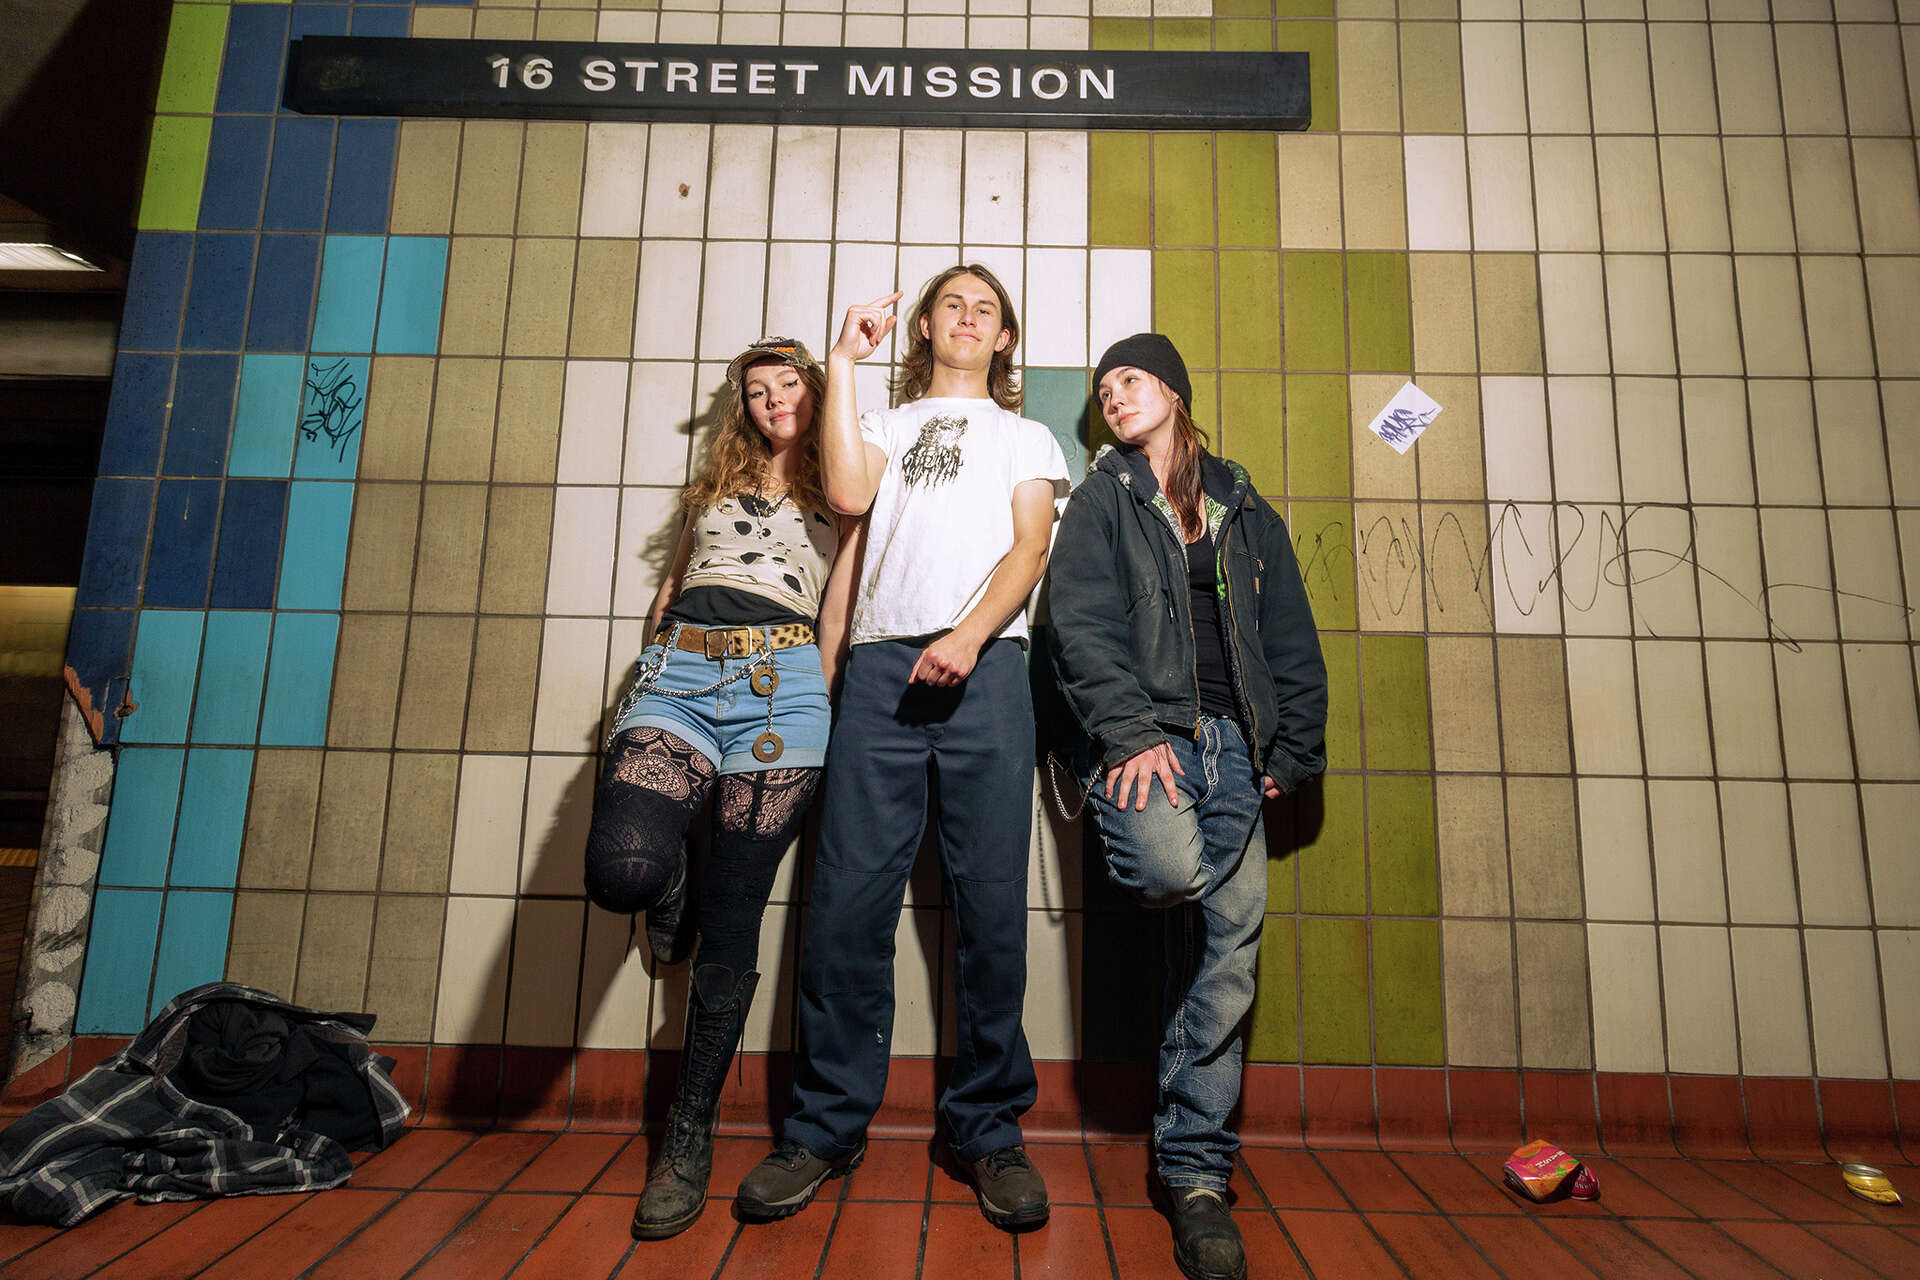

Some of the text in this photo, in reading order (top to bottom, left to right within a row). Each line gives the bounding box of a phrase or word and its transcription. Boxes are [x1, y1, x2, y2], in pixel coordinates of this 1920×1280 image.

[491, 57, 1115, 100] 16 STREET MISSION
